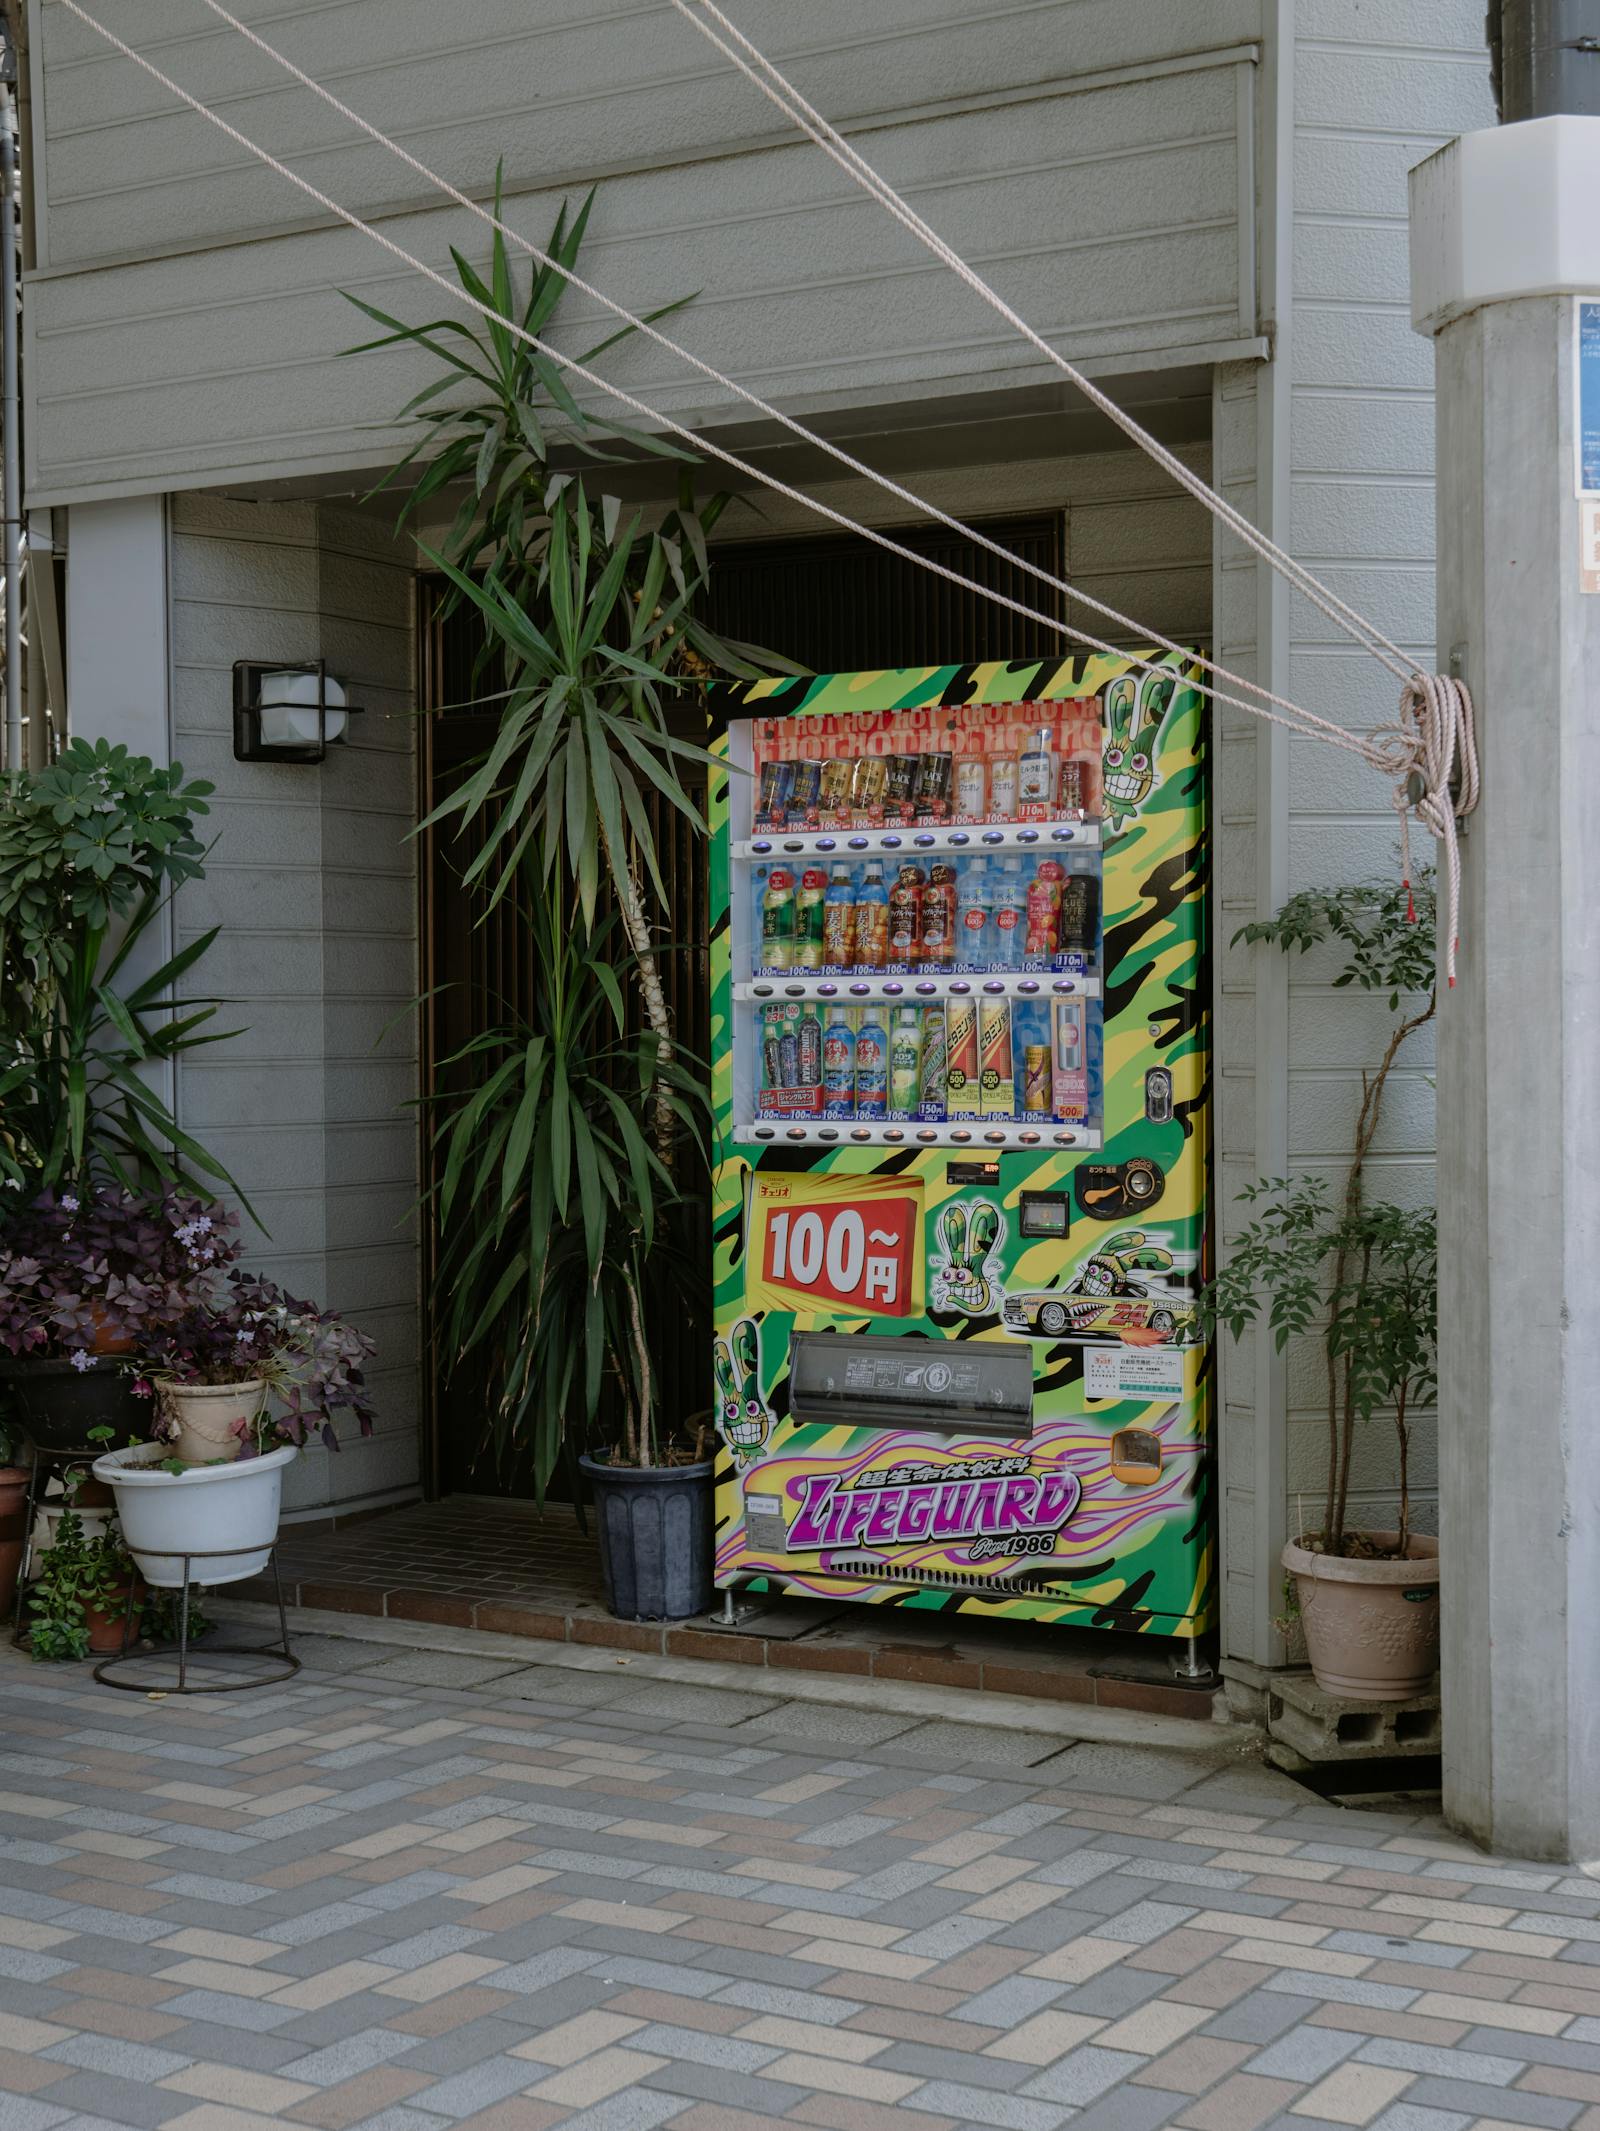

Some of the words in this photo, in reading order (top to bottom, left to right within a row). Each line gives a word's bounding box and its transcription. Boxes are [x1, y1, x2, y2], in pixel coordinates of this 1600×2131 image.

[766, 911, 776, 933] お茶
[799, 912, 808, 933] お茶
[827, 911, 844, 948] 麦茶
[856, 910, 872, 948] 麦茶
[787, 1006, 799, 1014] 500
[801, 1029, 812, 1083] JUNGLEMAN
[949, 1075, 965, 1084] 500
[982, 1075, 999, 1084] 500
[780, 1092, 813, 1100] ジャングルマン
[761, 1186, 790, 1197] チェリオ
[1108, 1303, 1149, 1328] 24
[856, 1458, 1030, 1486] 超生命体飲料
[787, 1472, 1081, 1550] LIFEGUARD
[971, 1538, 1008, 1559] Since
[1006, 1535, 1055, 1556] 1986
